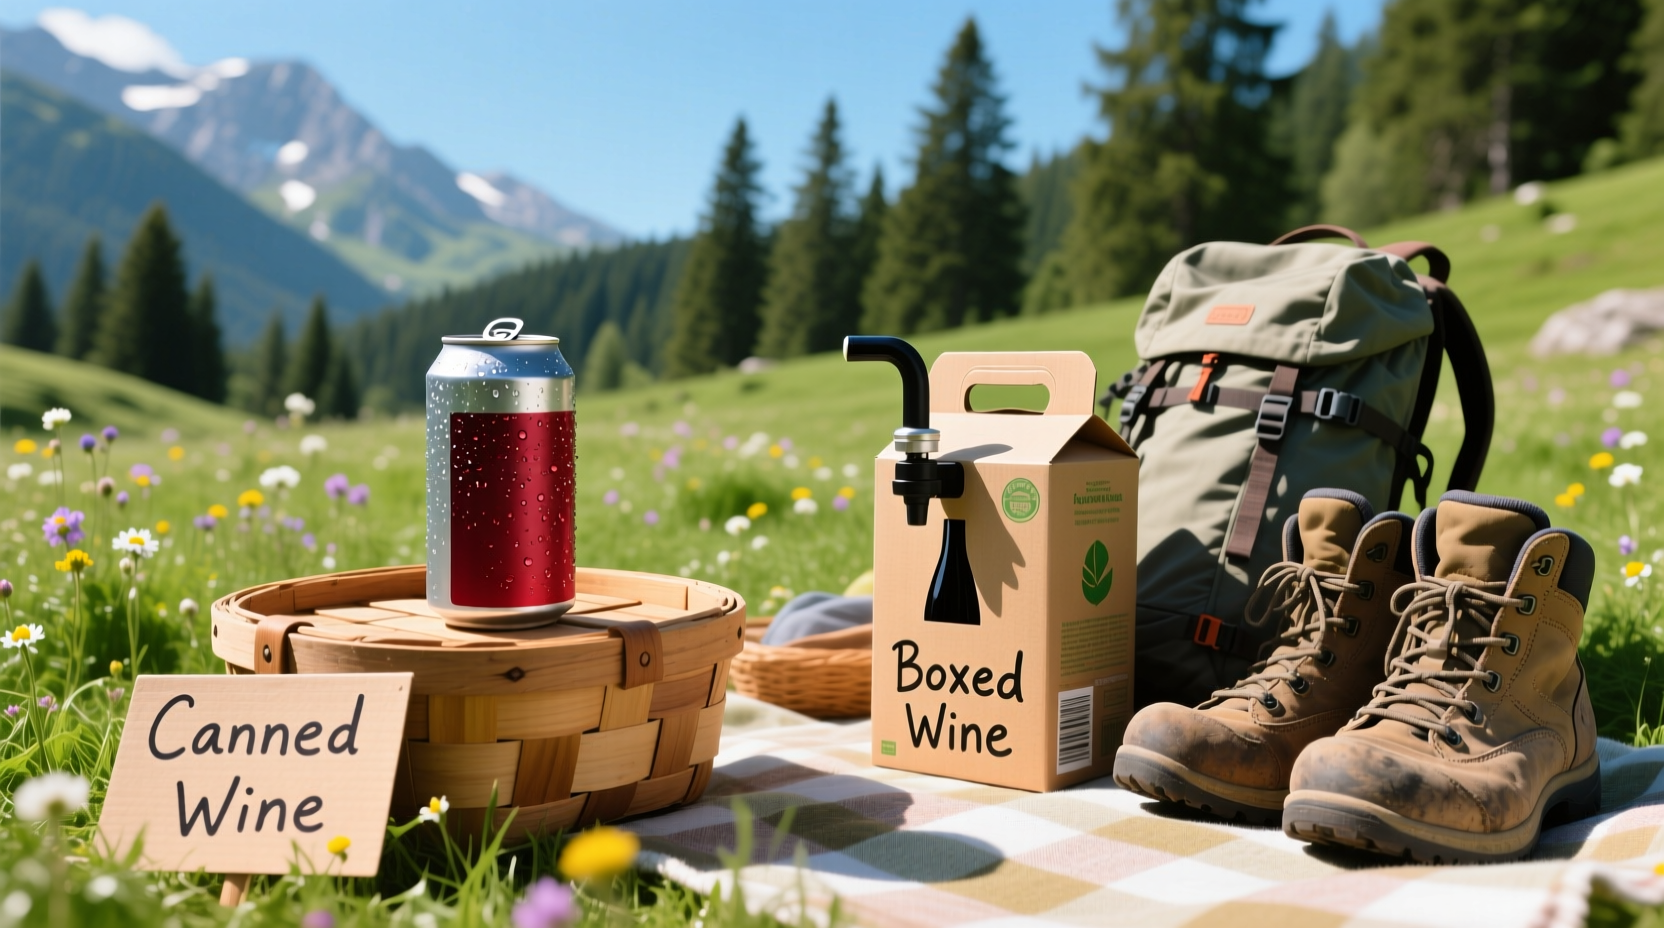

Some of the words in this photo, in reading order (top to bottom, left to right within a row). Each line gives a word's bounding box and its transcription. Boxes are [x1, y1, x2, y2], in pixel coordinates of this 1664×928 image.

[891, 639, 1024, 703] Boxed
[148, 693, 365, 760] Canned
[905, 702, 1013, 757] Wine
[176, 775, 324, 837] Wine
